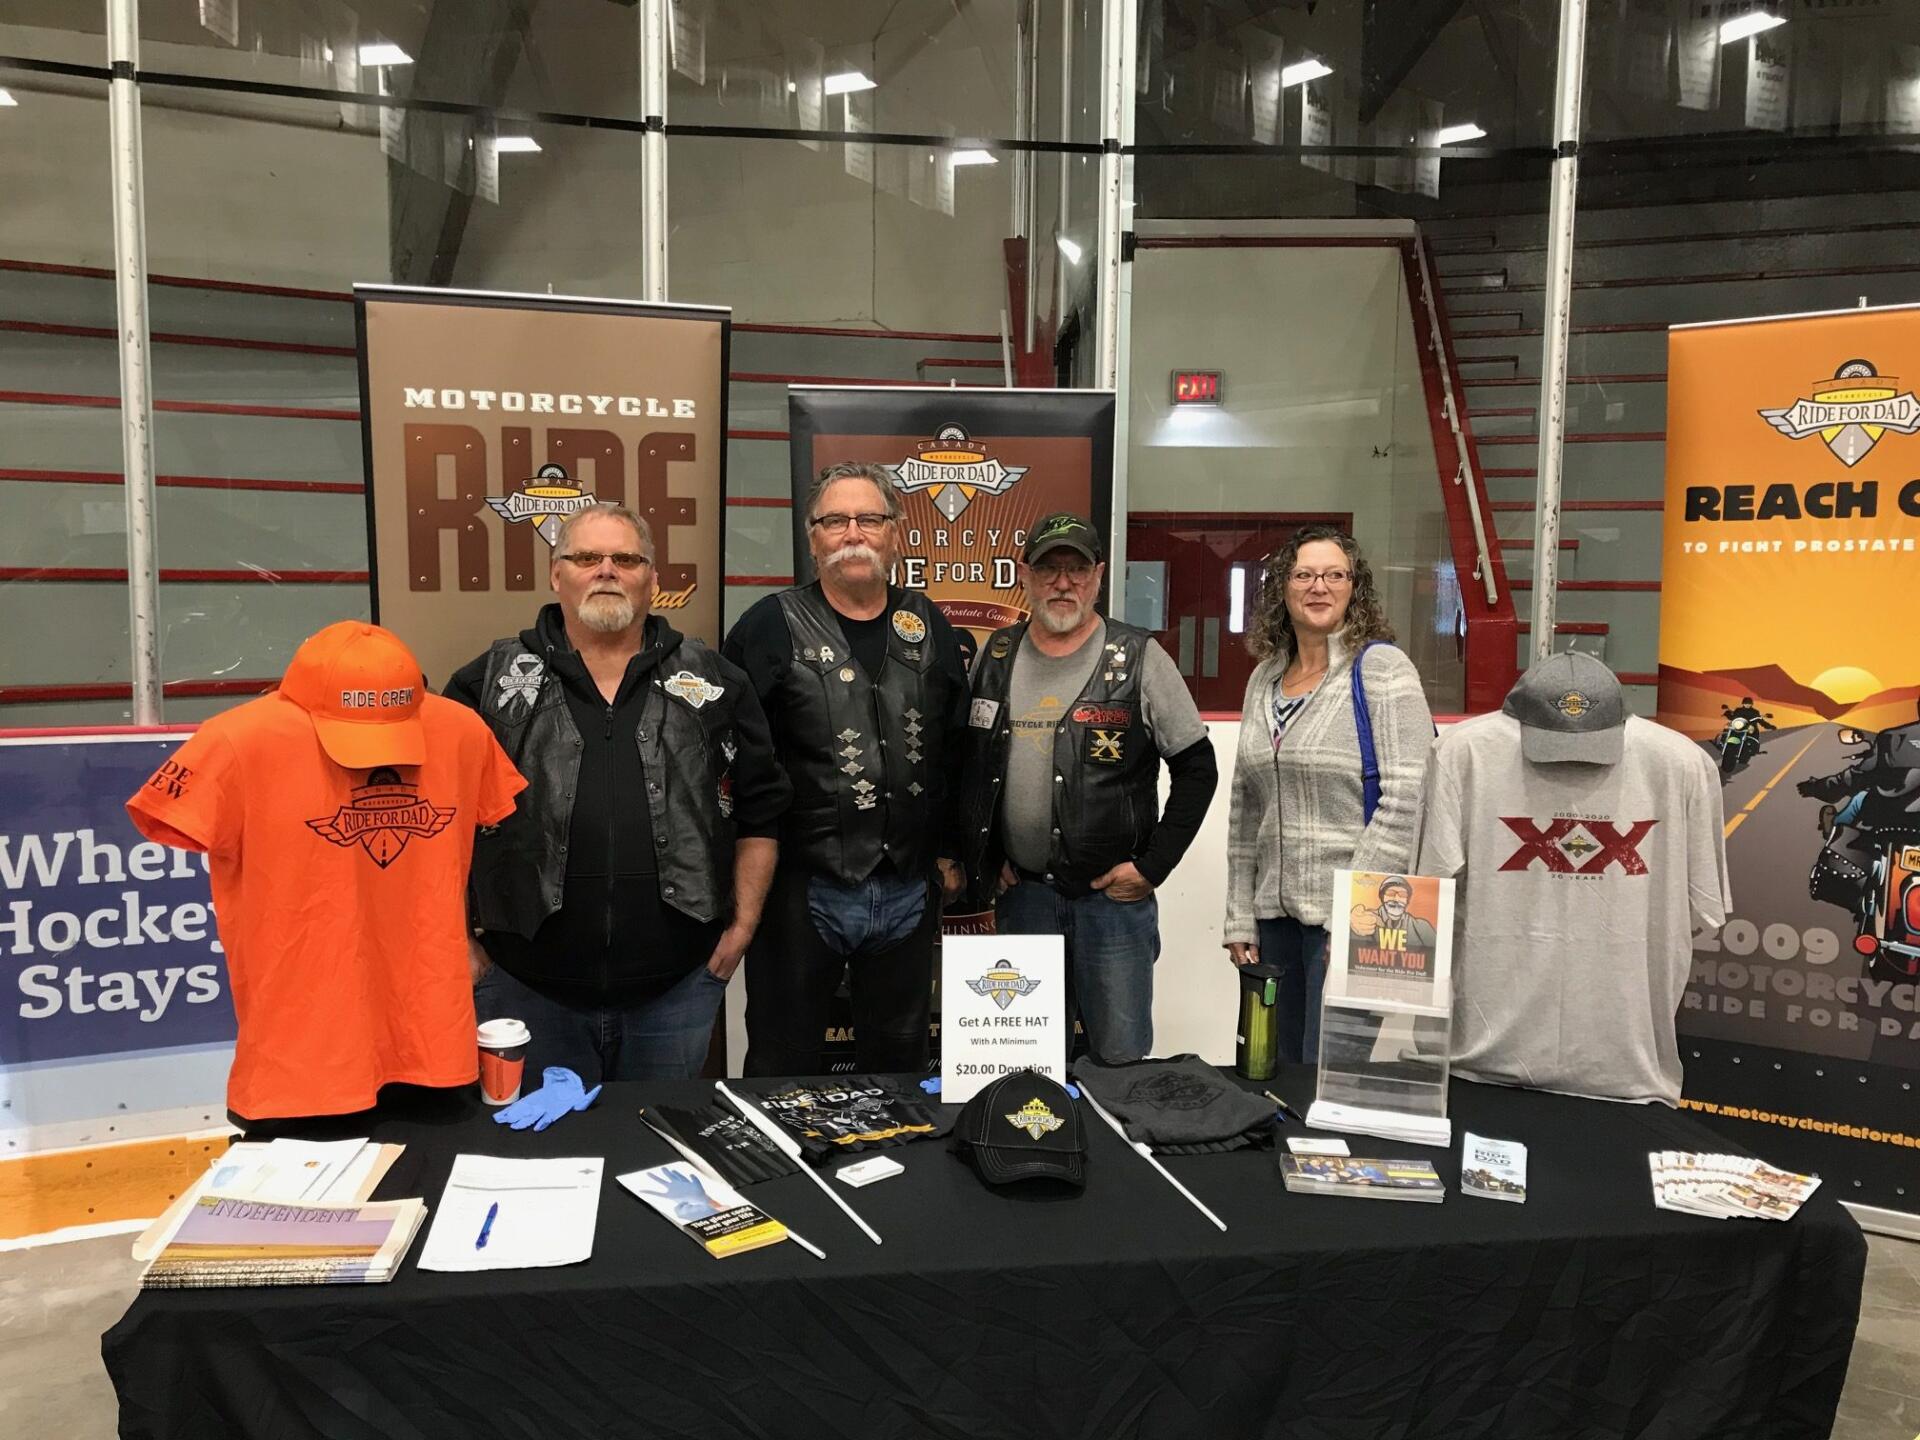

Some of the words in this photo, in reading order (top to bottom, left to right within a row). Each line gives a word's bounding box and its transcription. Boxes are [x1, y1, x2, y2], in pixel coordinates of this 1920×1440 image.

[1177, 374, 1217, 400] EXIT
[404, 387, 696, 419] MOTORCYCLE
[1799, 404, 1836, 426] RIDE
[1838, 405, 1870, 421] FOR
[1874, 399, 1911, 420] DAD
[918, 441, 987, 452] CANADA
[907, 461, 938, 482] RIDE
[940, 466, 966, 480] FOR
[968, 463, 997, 483] DAD
[514, 495, 544, 513] RIDE
[545, 499, 567, 512] FOR
[1684, 481, 1879, 522] REACH
[909, 529, 1026, 547] ORCYC
[1683, 541, 1708, 553] TO
[1719, 539, 1783, 553] FIGHT
[1794, 538, 1915, 552] PROSTATE
[934, 562, 985, 582] FOR
[341, 690, 376, 708] RIDE
[381, 687, 415, 708] CREW
[160, 760, 193, 785] DE
[149, 774, 190, 799] EW
[343, 812, 371, 833] RIDE
[373, 811, 398, 826] FOR
[400, 806, 429, 826] DAD
[0, 829, 210, 889] Wher
[1378, 928, 1408, 951] WE
[1692, 919, 1840, 965] 2009
[1358, 948, 1397, 968] WANT
[1401, 951, 1426, 970] YOU
[18, 965, 220, 1023] Stays
[1689, 959, 1920, 1013] MOTORCYC
[958, 1016, 980, 1027] Get
[982, 1016, 991, 1027] A
[994, 1016, 1022, 1027] FREE
[1025, 1016, 1049, 1027] HAT
[1684, 990, 1766, 1019] RIDE
[1786, 1004, 1858, 1031] FOR
[970, 1037, 990, 1046] With
[1000, 1037, 1038, 1046] Minimum
[956, 1062, 995, 1077] $20.00
[826, 1088, 884, 1103] DAD
[1474, 1154, 1511, 1165] DAD
[1475, 1149, 1510, 1159] RIDE
[208, 1200, 361, 1224] INDEPENDENT
